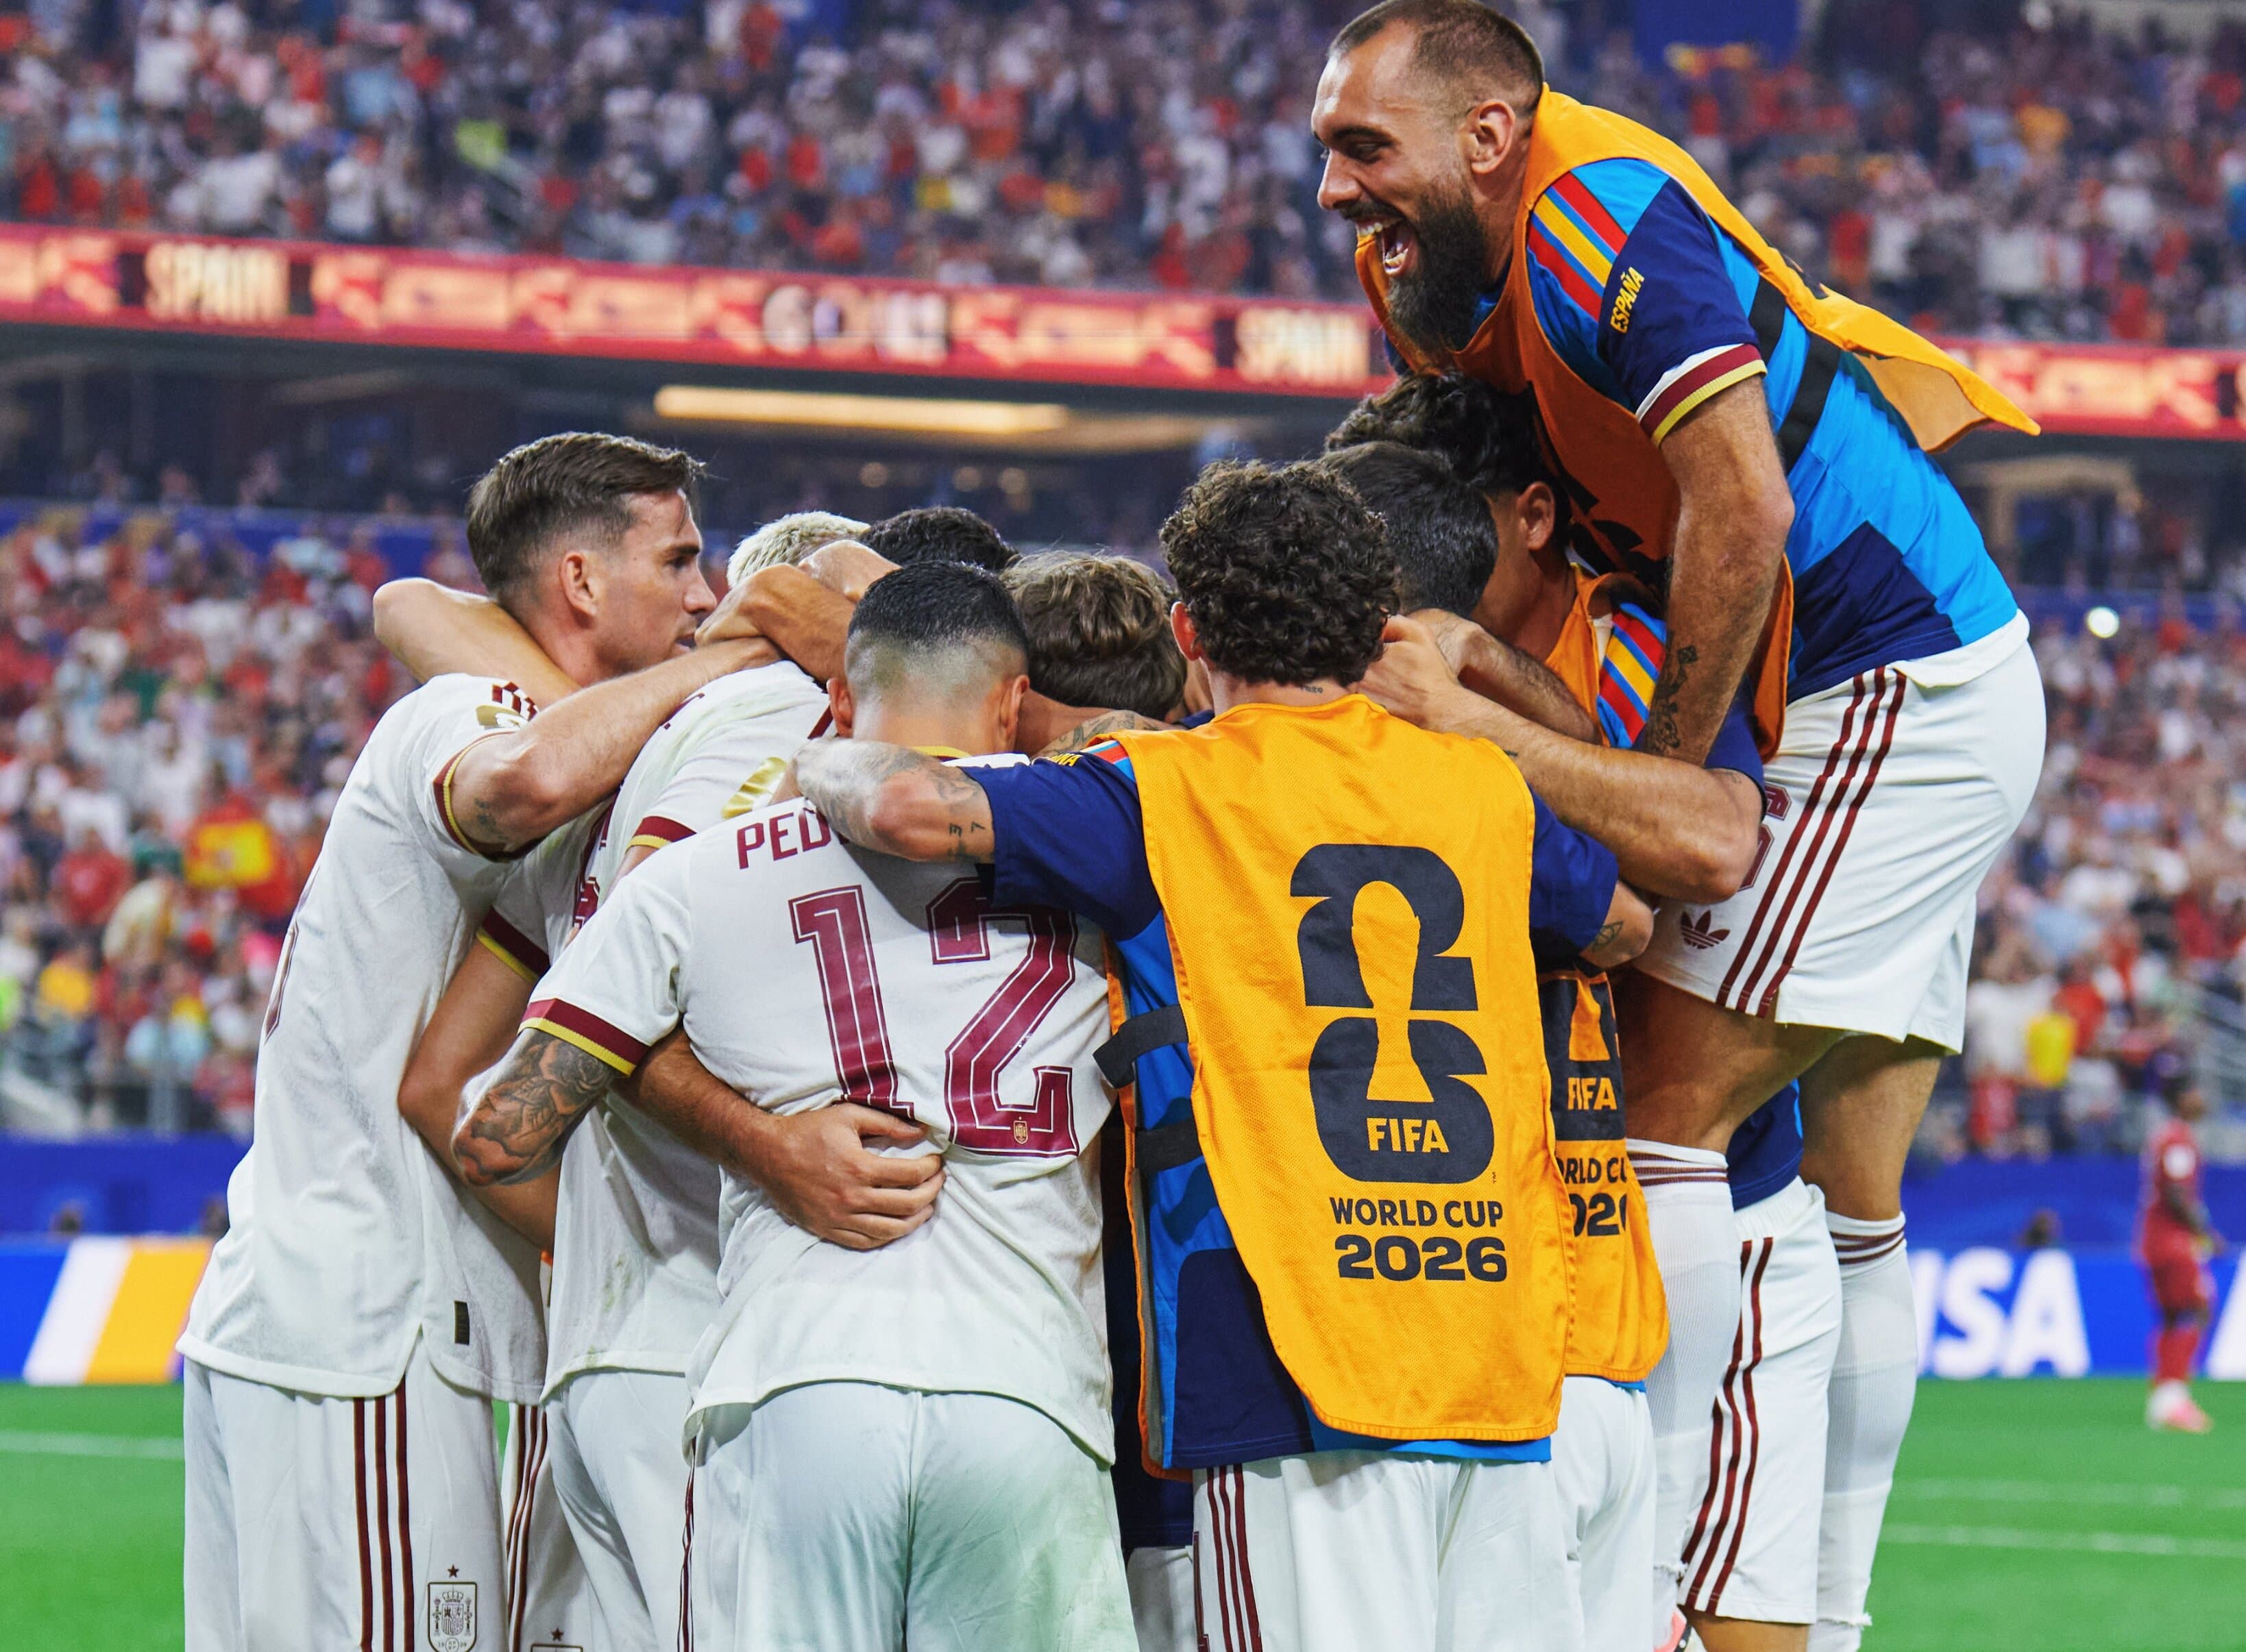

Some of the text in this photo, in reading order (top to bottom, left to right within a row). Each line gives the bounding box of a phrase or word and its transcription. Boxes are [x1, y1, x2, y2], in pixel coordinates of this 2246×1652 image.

[145, 241, 286, 323] SPAIN
[1611, 267, 1644, 333] ESPAÑA
[737, 807, 850, 870] PED
[788, 877, 1080, 1157] 12
[1567, 1077, 1618, 1111] FIFA
[1366, 1117, 1450, 1152] FIFA
[1329, 1196, 1503, 1228] WORLD CUP
[1334, 1234, 1508, 1282] 2026
[1908, 1247, 2092, 1379] ISA
